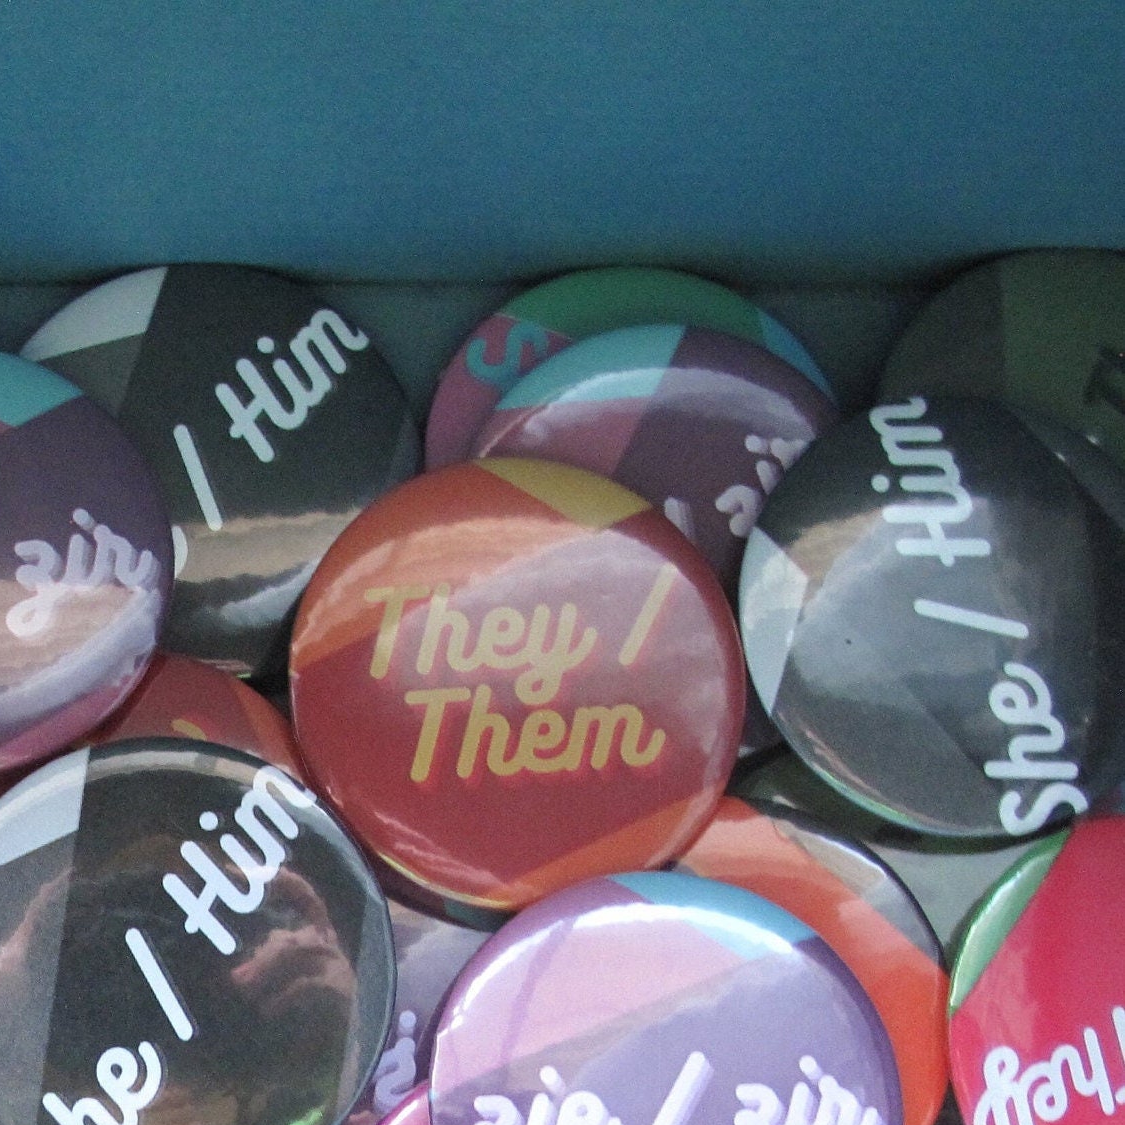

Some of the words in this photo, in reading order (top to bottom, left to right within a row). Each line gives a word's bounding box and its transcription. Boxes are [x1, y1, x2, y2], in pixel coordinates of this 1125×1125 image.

[215, 306, 369, 462] Him
[868, 396, 993, 568] Him
[5, 508, 163, 640] zir
[361, 581, 600, 709] They
[404, 685, 667, 786] Them
[983, 663, 1089, 836] She
[161, 765, 317, 957] Him
